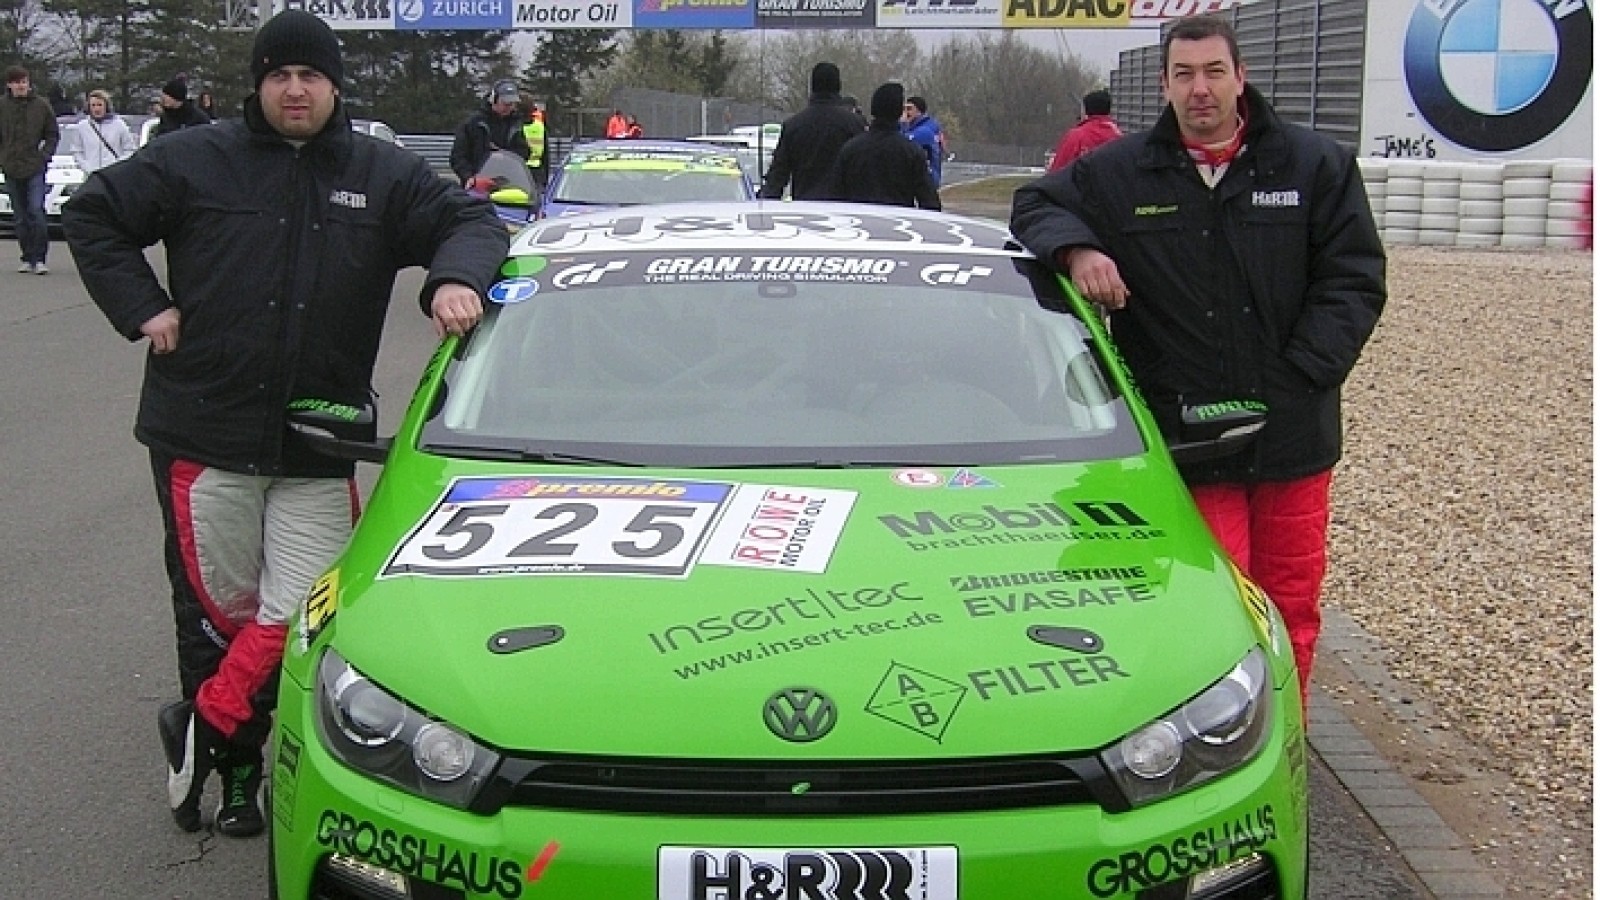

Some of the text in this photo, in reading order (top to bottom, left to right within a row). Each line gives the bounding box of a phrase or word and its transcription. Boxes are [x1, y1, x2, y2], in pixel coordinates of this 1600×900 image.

[432, 0, 502, 17] ZURICH
[516, 4, 618, 22] Motor Oil
[1006, 0, 1116, 18] ADAC
[643, 273, 889, 283] THE REAL DRIVING SIMULATOR
[647, 255, 896, 274] GRAN TURISMO
[526, 482, 687, 498] premio
[421, 503, 697, 562] 525
[735, 490, 810, 566] ROWE
[779, 498, 827, 567] MOTOR OIL
[877, 502, 1150, 538] Mobil 1
[950, 565, 1147, 592] BRIDGESTONE
[963, 583, 1156, 618] EVASAFE
[673, 609, 944, 681] www.insert-tec.de
[896, 672, 927, 698] A
[967, 653, 1133, 701] FILTER
[908, 701, 940, 729] B
[317, 809, 523, 900] GROSSHAUS
[1086, 803, 1278, 899] GROSSHAUS
